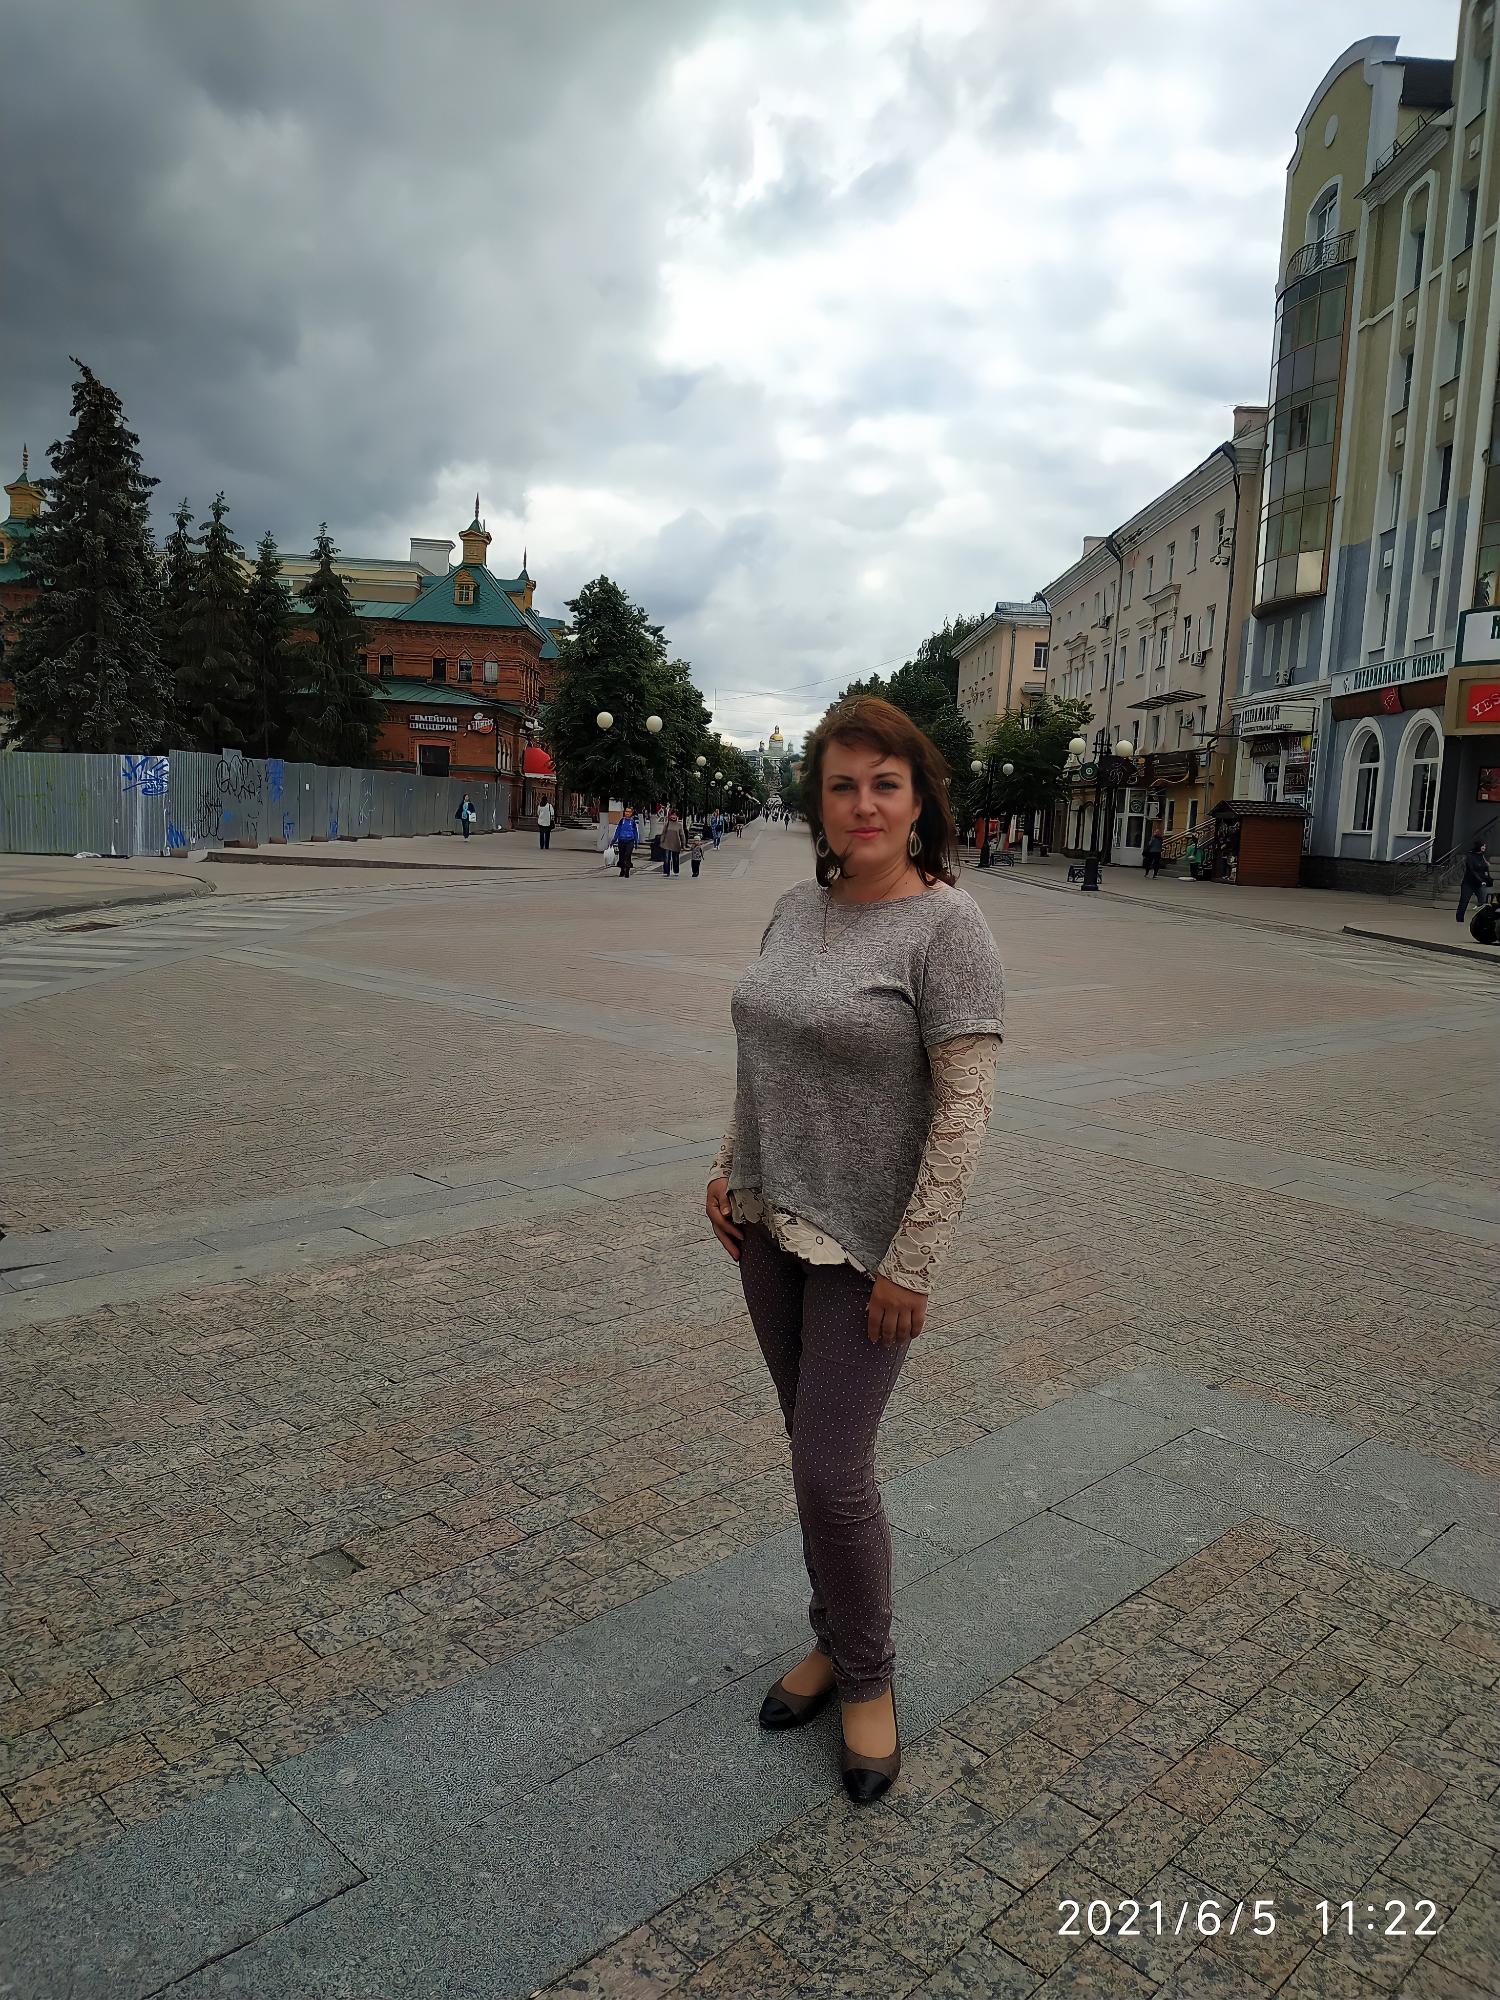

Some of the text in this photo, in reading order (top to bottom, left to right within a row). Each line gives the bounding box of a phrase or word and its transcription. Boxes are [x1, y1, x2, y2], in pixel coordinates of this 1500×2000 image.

[1353, 652, 1446, 690] НОТАРИАЛЬНАЯ КОНТОРА
[410, 714, 458, 723] СЕМЕЙНАЯ
[410, 723, 458, 731] ПИЦЦЕРИЯ
